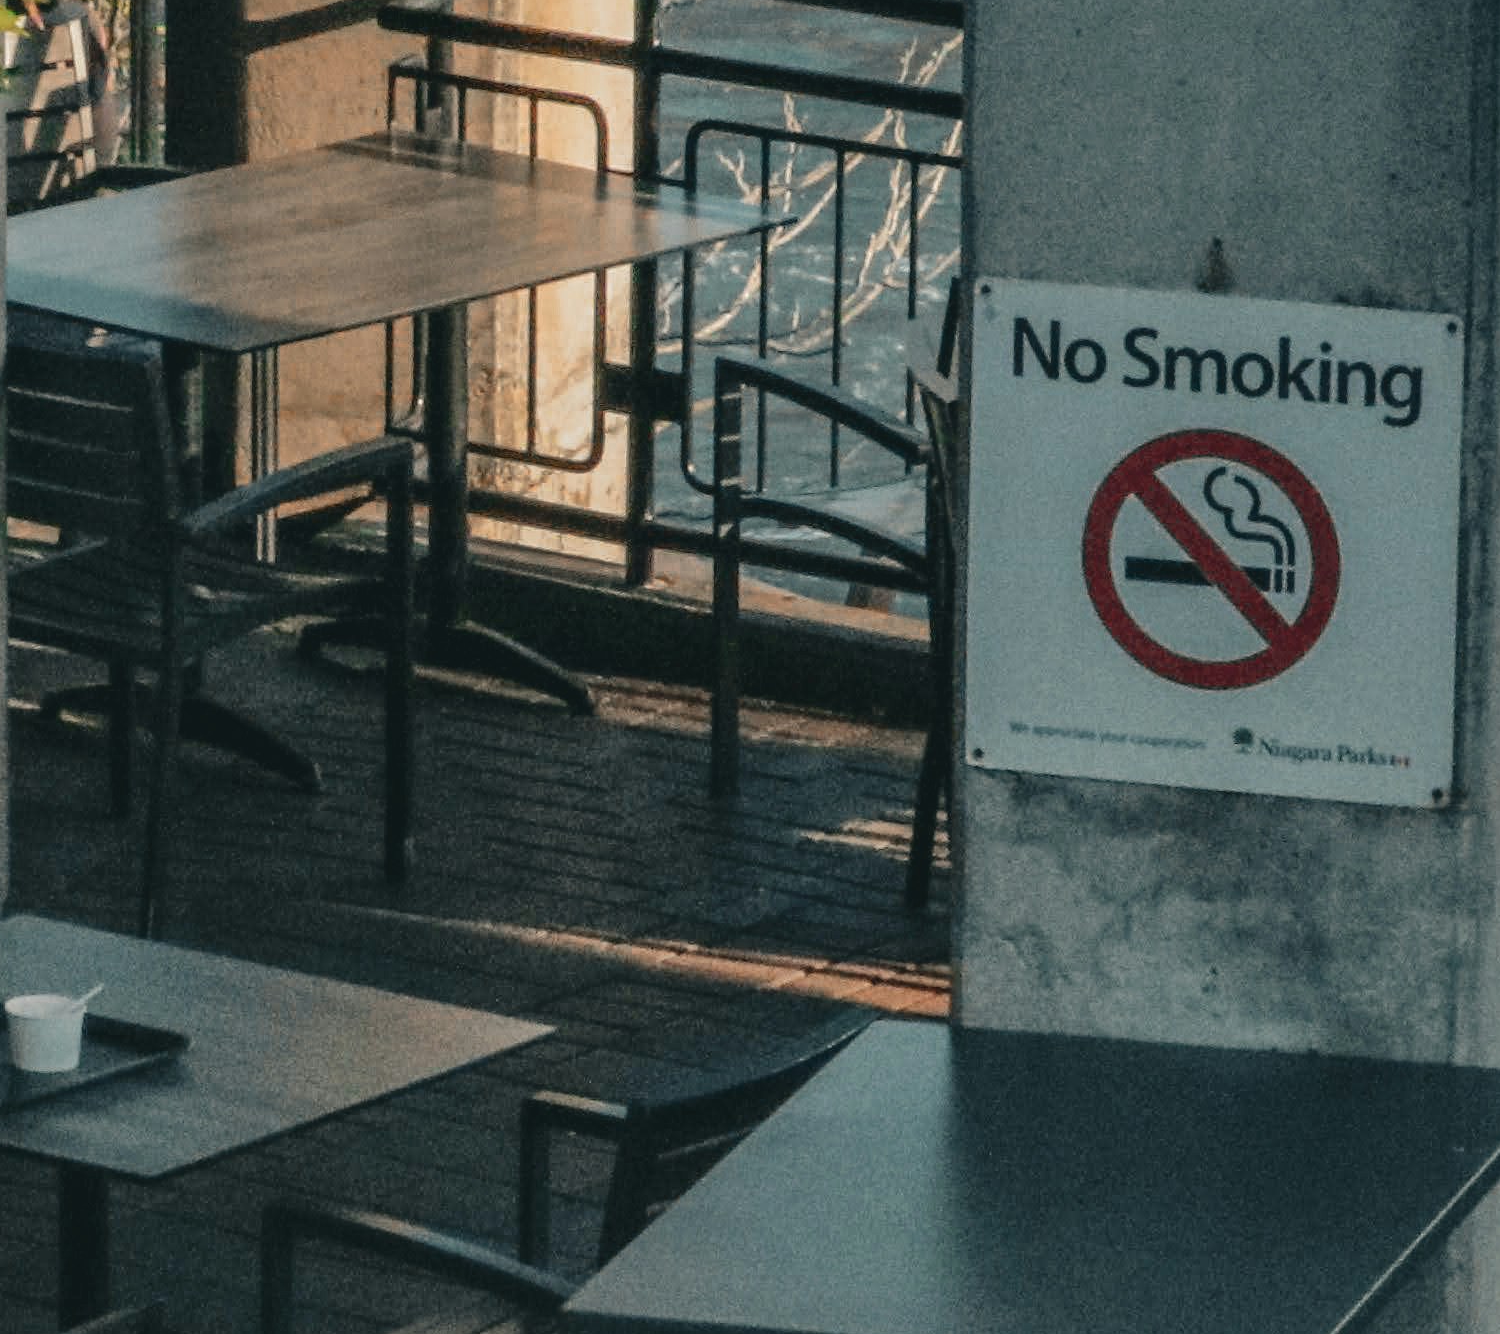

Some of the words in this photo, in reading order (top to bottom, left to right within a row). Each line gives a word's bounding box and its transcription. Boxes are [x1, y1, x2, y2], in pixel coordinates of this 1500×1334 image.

[1011, 315, 1108, 385] No
[1122, 326, 1424, 428] Smoking
[1259, 737, 1332, 762] Niagara
